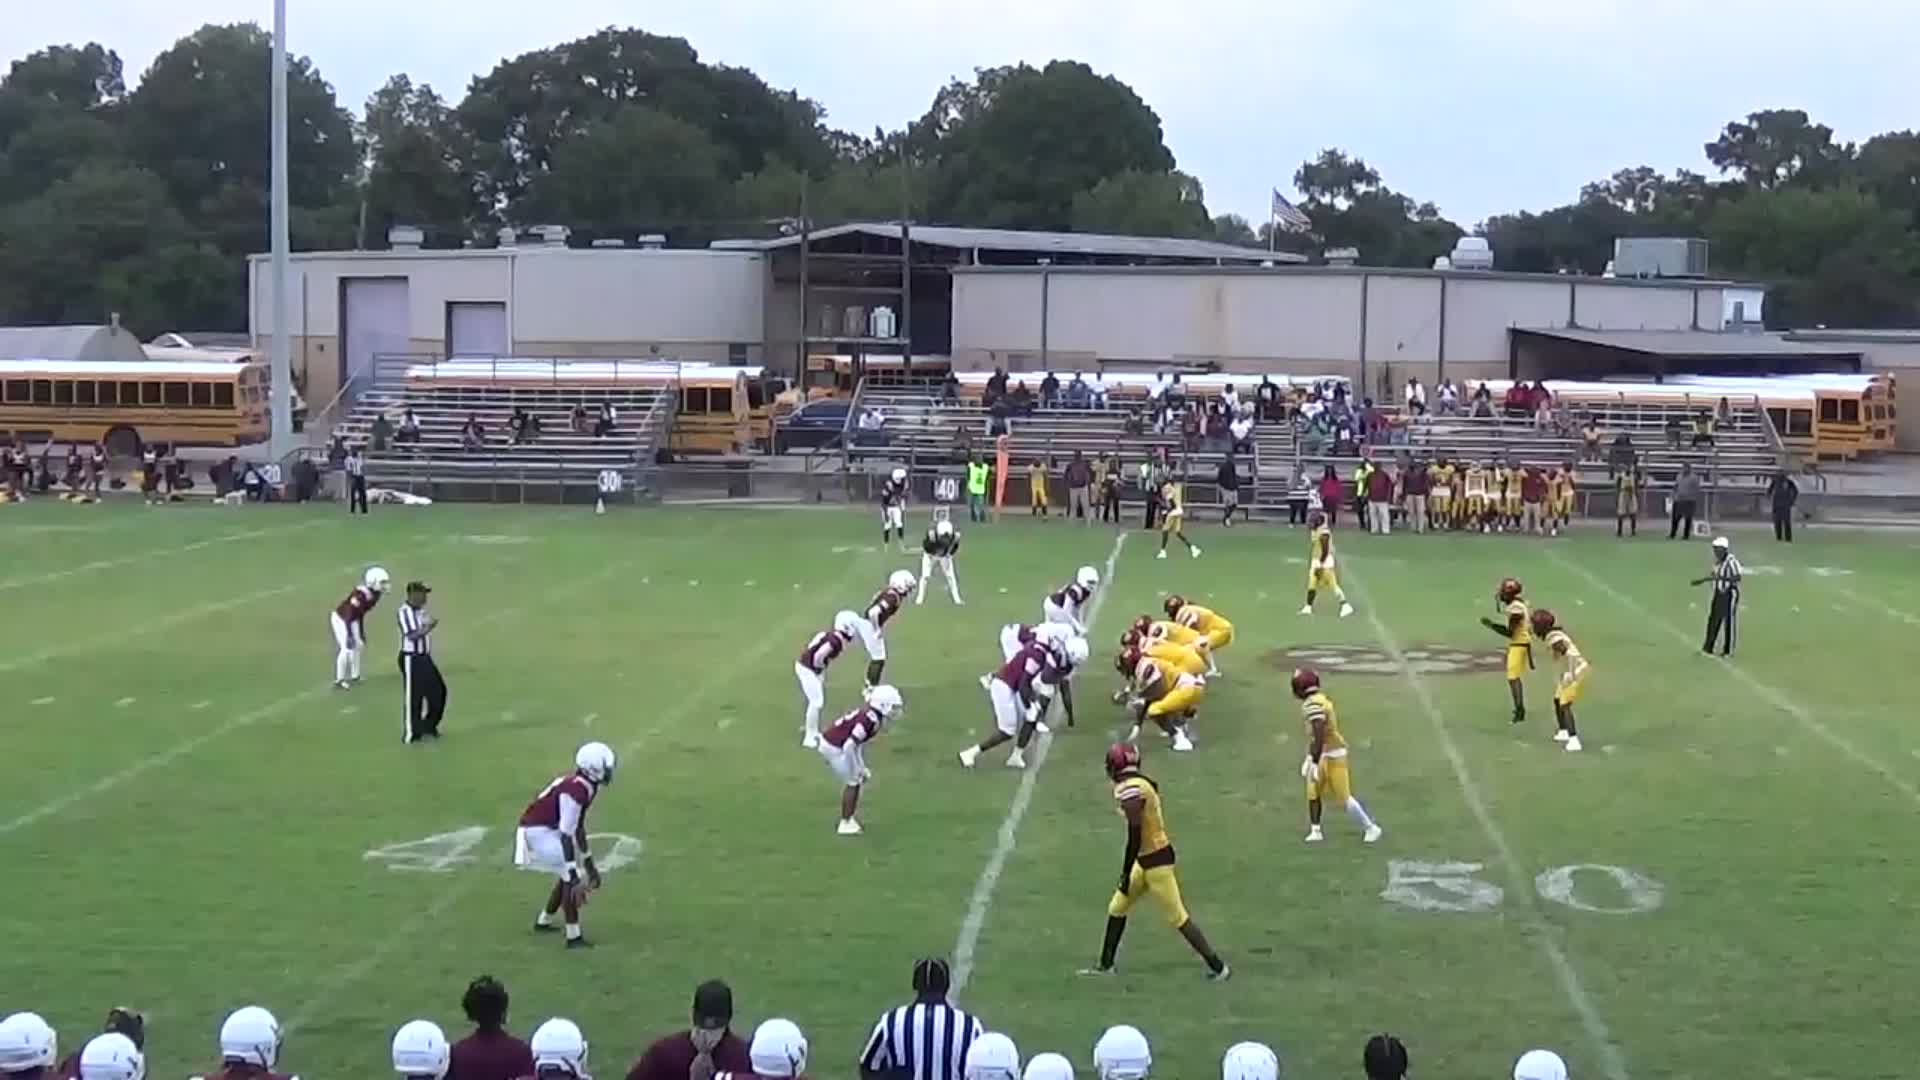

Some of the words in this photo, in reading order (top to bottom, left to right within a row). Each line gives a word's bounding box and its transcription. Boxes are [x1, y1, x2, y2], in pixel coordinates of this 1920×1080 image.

[600, 470, 618, 492] 30
[937, 479, 956, 500] 40
[1380, 859, 1664, 913] 50
